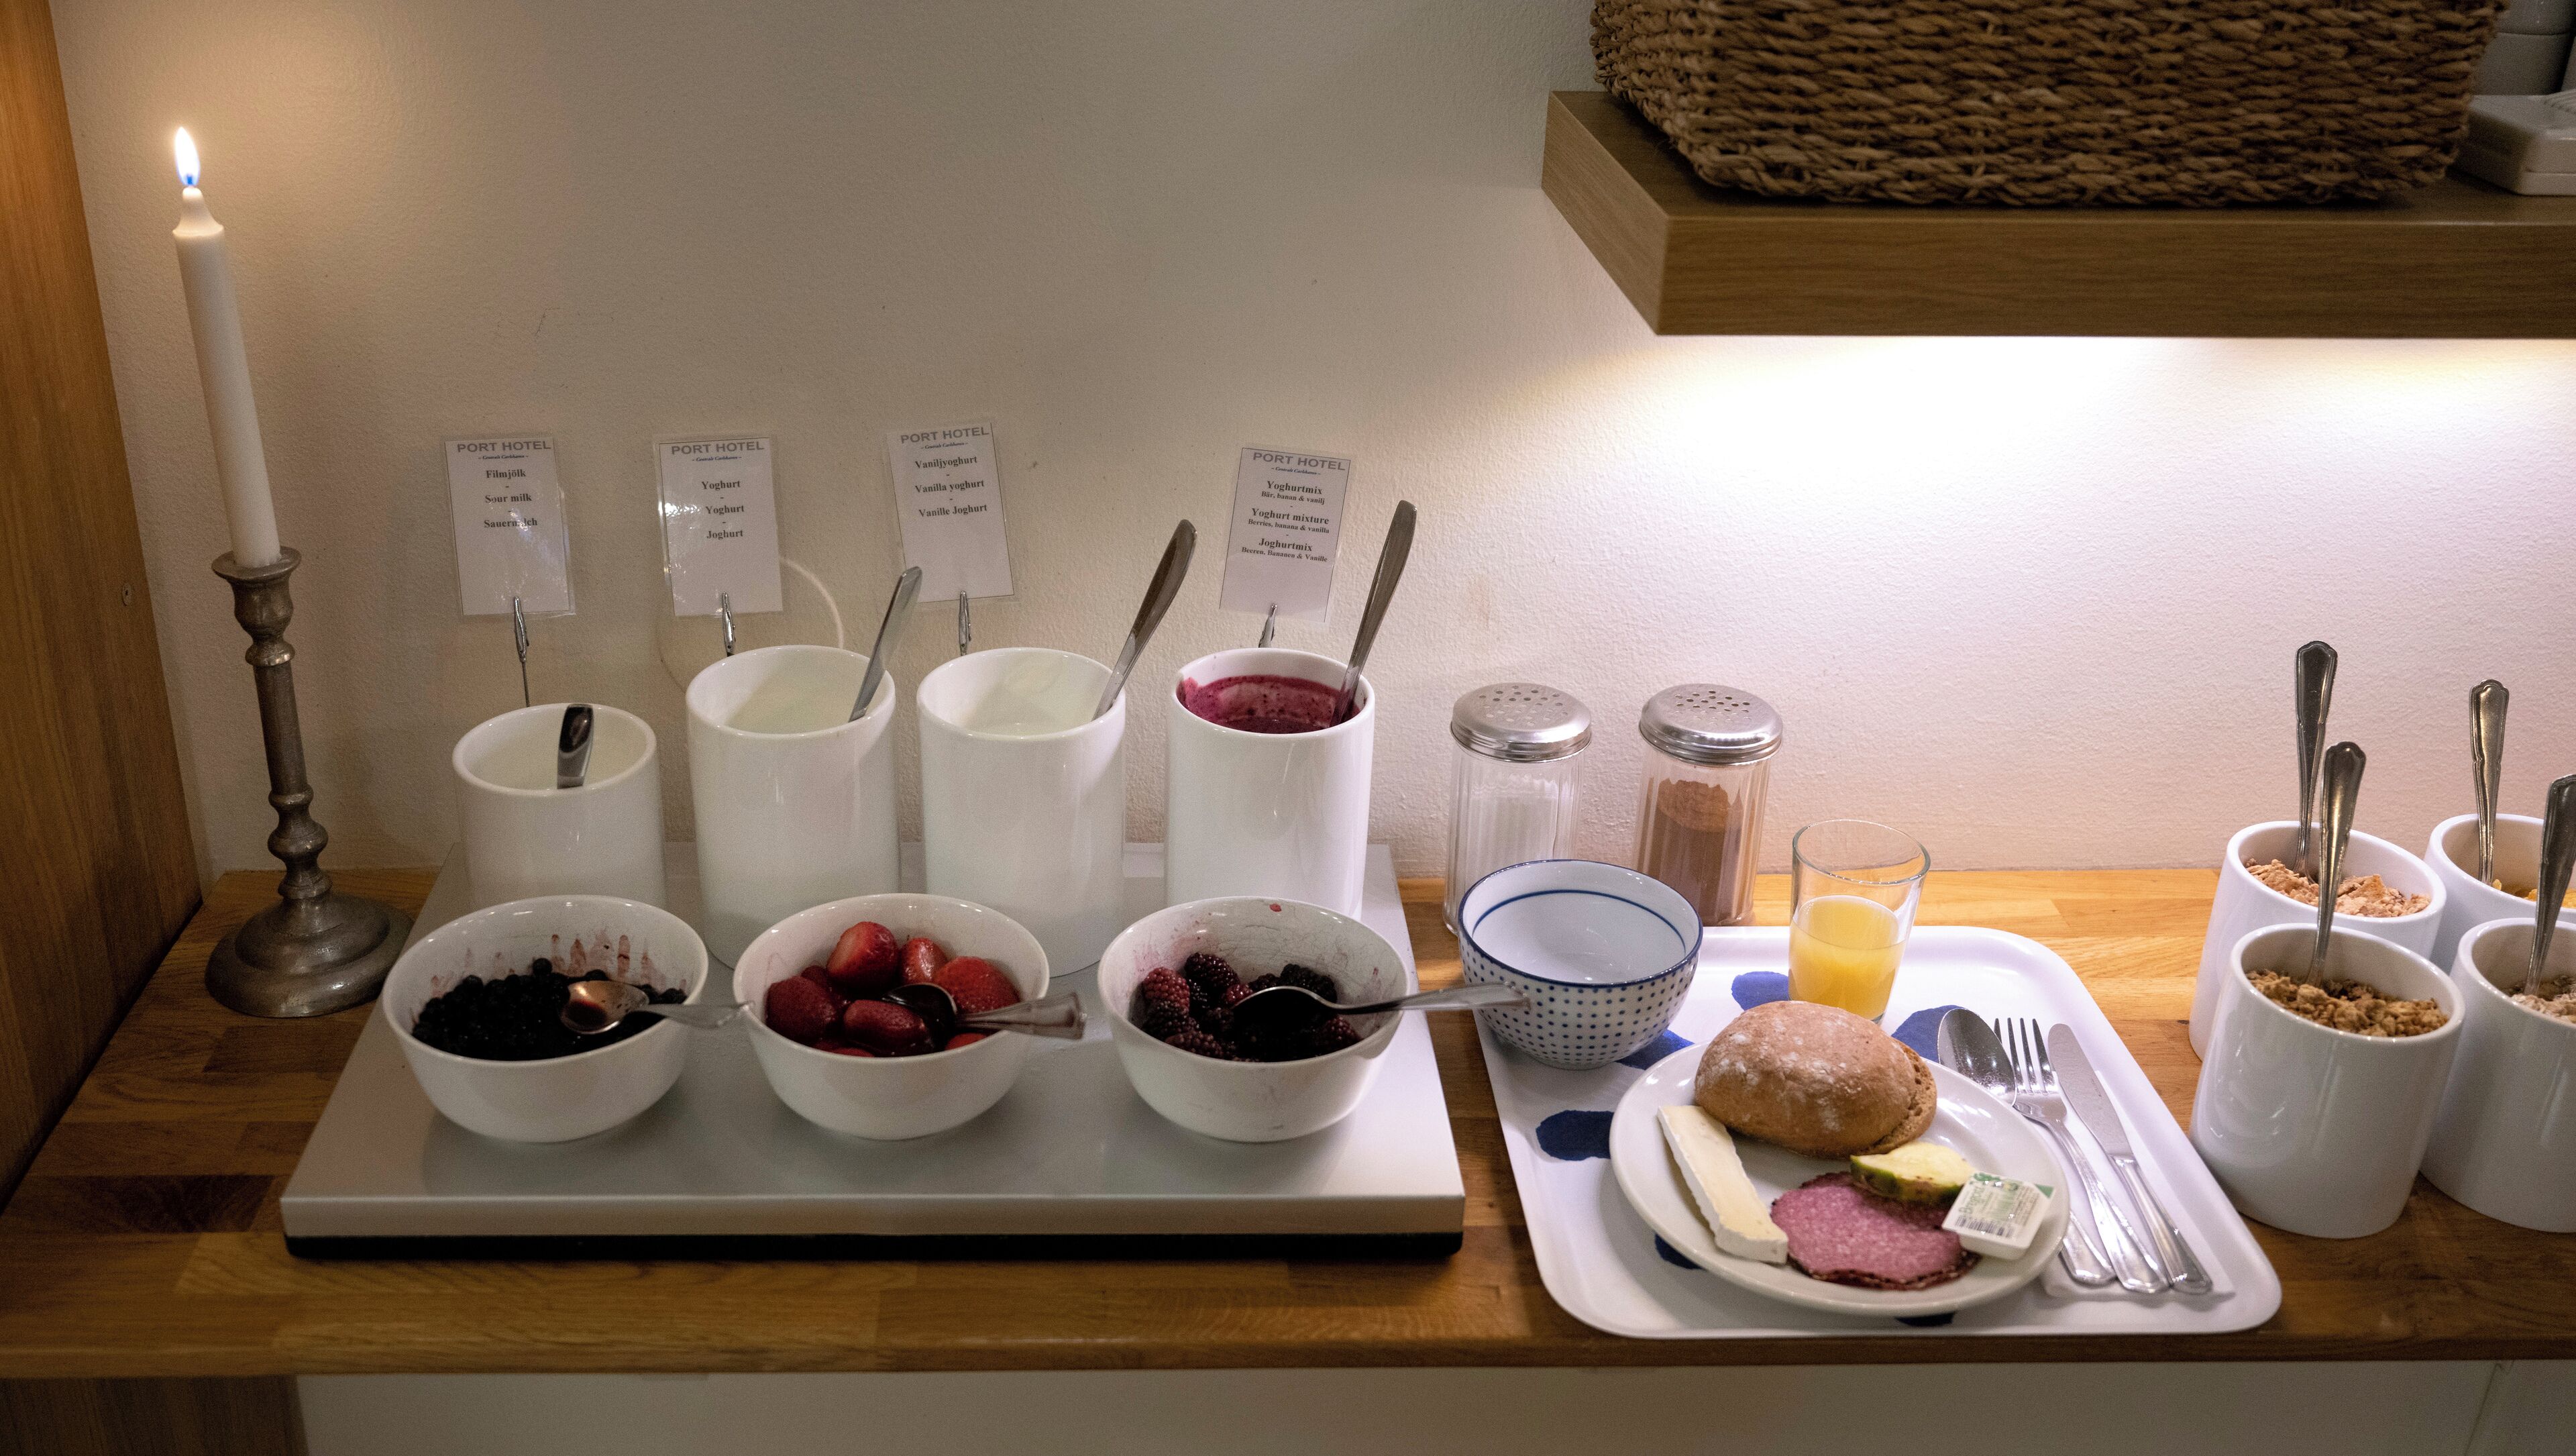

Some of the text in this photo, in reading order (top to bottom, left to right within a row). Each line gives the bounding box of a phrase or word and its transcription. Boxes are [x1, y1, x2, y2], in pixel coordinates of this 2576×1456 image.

[900, 427, 989, 444] PORT HOTEL
[458, 441, 551, 452] PORT HOTEL
[672, 441, 765, 455] PORT HOTEL
[915, 456, 977, 469] Vaniljyoghurt
[1253, 452, 1346, 470] PORT HOTEL
[486, 469, 527, 480] Filmjölk
[701, 480, 741, 491] Yoghurt
[915, 479, 985, 493] Vanilla yoghurt
[1267, 480, 1323, 495] Yoghurtmix
[485, 493, 532, 504] Sour milk
[1307, 497, 1325, 505] vanilj
[706, 505, 745, 515] Yoghurt
[918, 504, 987, 517] Vanille Joghurt
[1252, 508, 1330, 525] Yoghurt mixture
[484, 518, 538, 528] Sauermlch
[1275, 522, 1298, 530] banana
[706, 529, 744, 540] Joghurt
[1258, 538, 1313, 552] Joghurtmix
[1267, 550, 1295, 558] Bananen
[1305, 554, 1328, 562] Vanille
